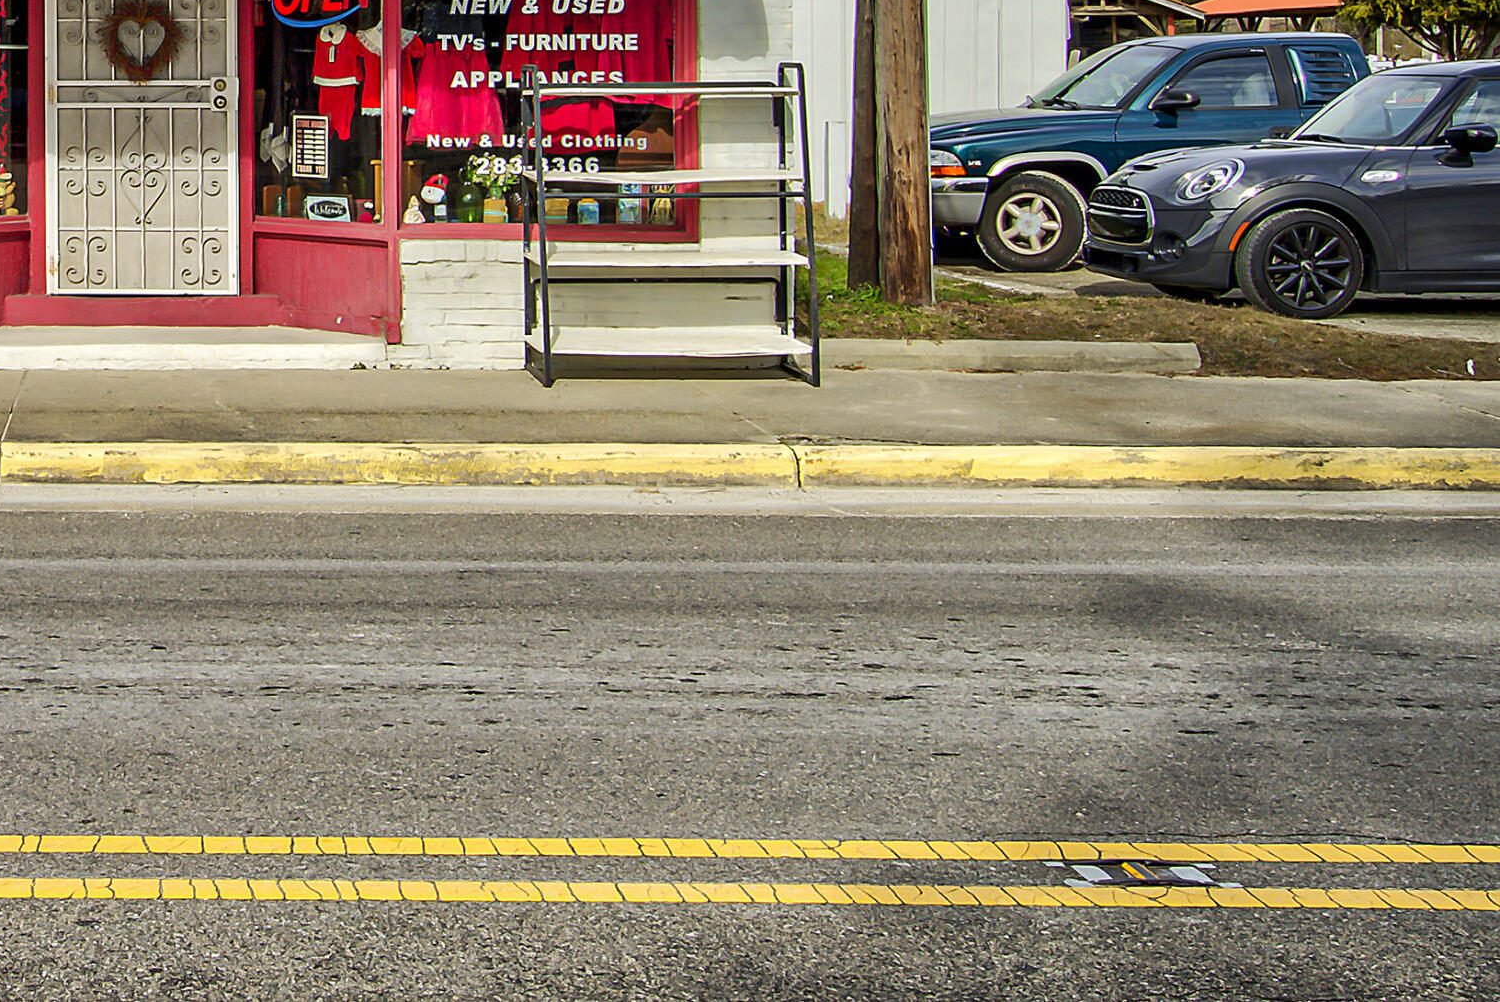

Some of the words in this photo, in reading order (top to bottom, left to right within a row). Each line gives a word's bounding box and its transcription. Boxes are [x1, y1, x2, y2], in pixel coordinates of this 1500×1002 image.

[437, 33, 485, 51] TV's
[506, 32, 639, 51] FURNITURE
[427, 135, 470, 148] New
[479, 134, 493, 148] &
[503, 134, 552, 148] Used
[561, 134, 649, 150] Clothing
